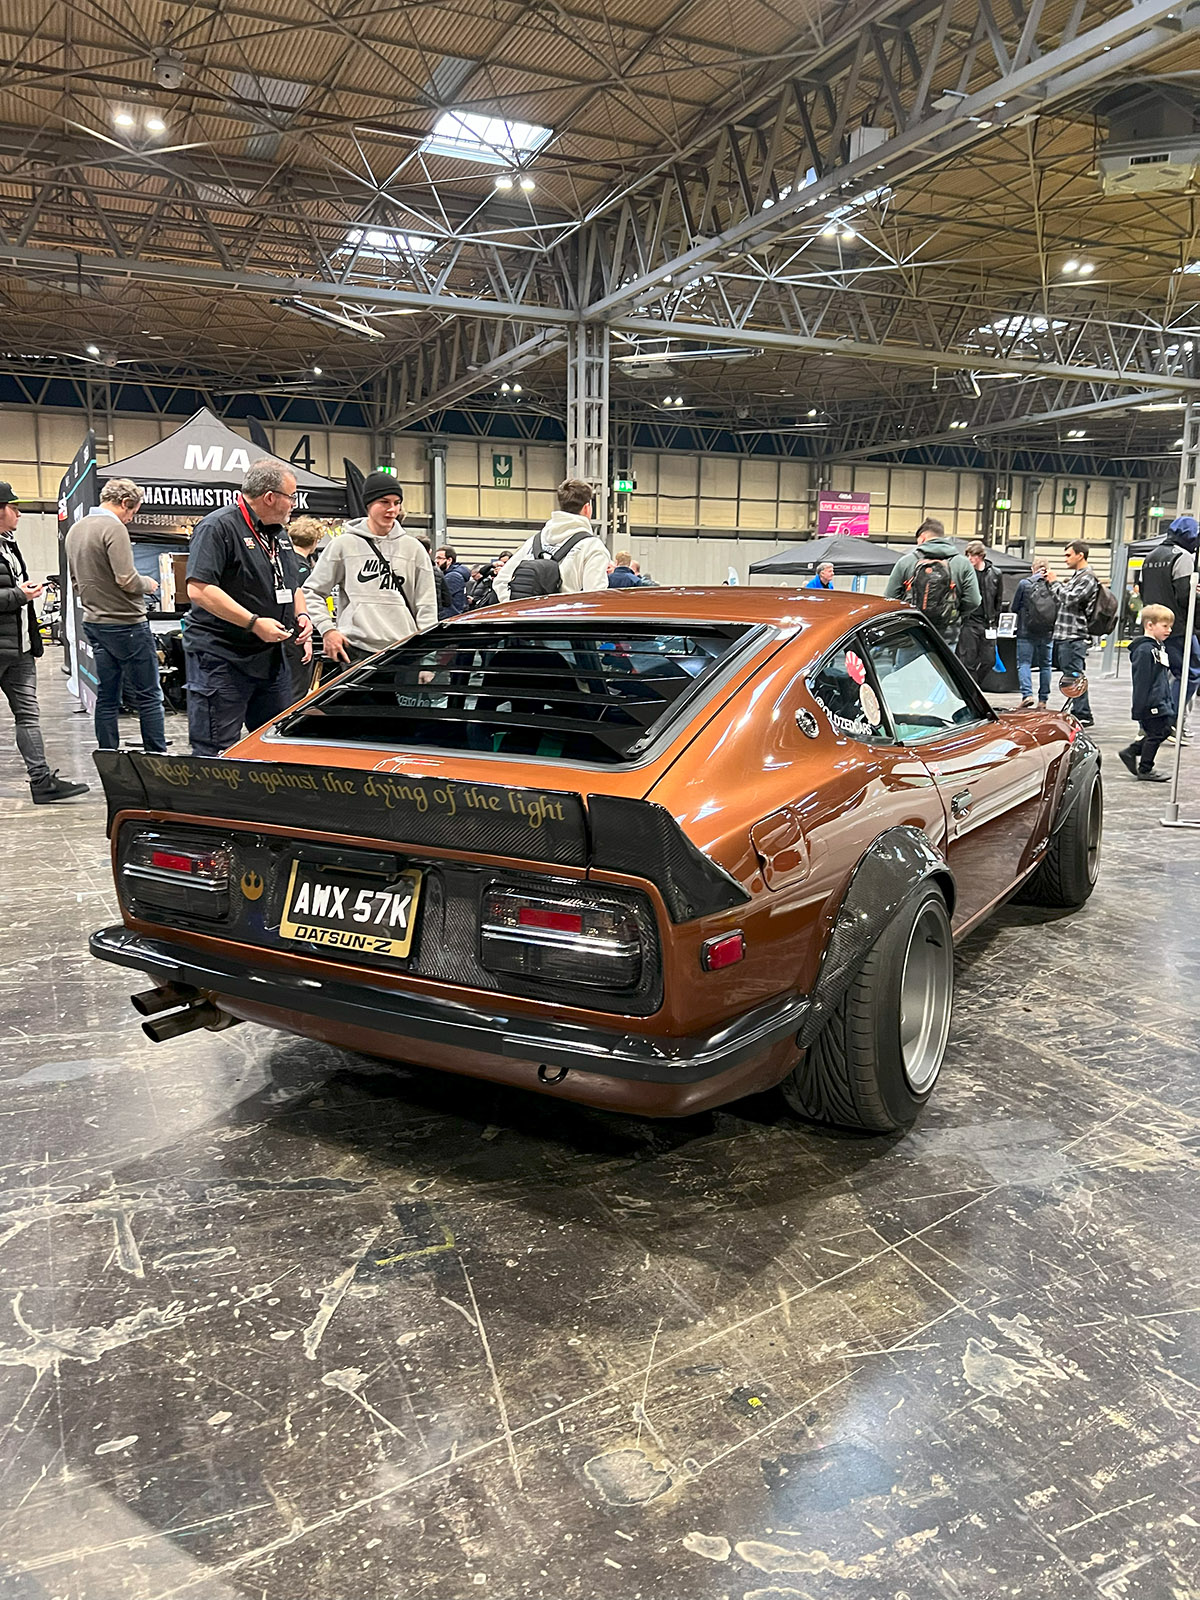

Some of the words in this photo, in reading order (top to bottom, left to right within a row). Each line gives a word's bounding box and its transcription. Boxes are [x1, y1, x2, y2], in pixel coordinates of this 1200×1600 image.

[290, 434, 316, 471] 4
[496, 477, 510, 487] EXIT
[201, 765, 244, 790] rage
[248, 768, 319, 794] against
[322, 772, 357, 794] the
[364, 776, 428, 812] dying
[433, 784, 456, 816] of
[463, 787, 502, 811] the
[508, 792, 565, 829] light
[293, 882, 350, 920] AWX
[352, 889, 412, 929] 57K
[294, 926, 392, 953] DATSUN-Z
